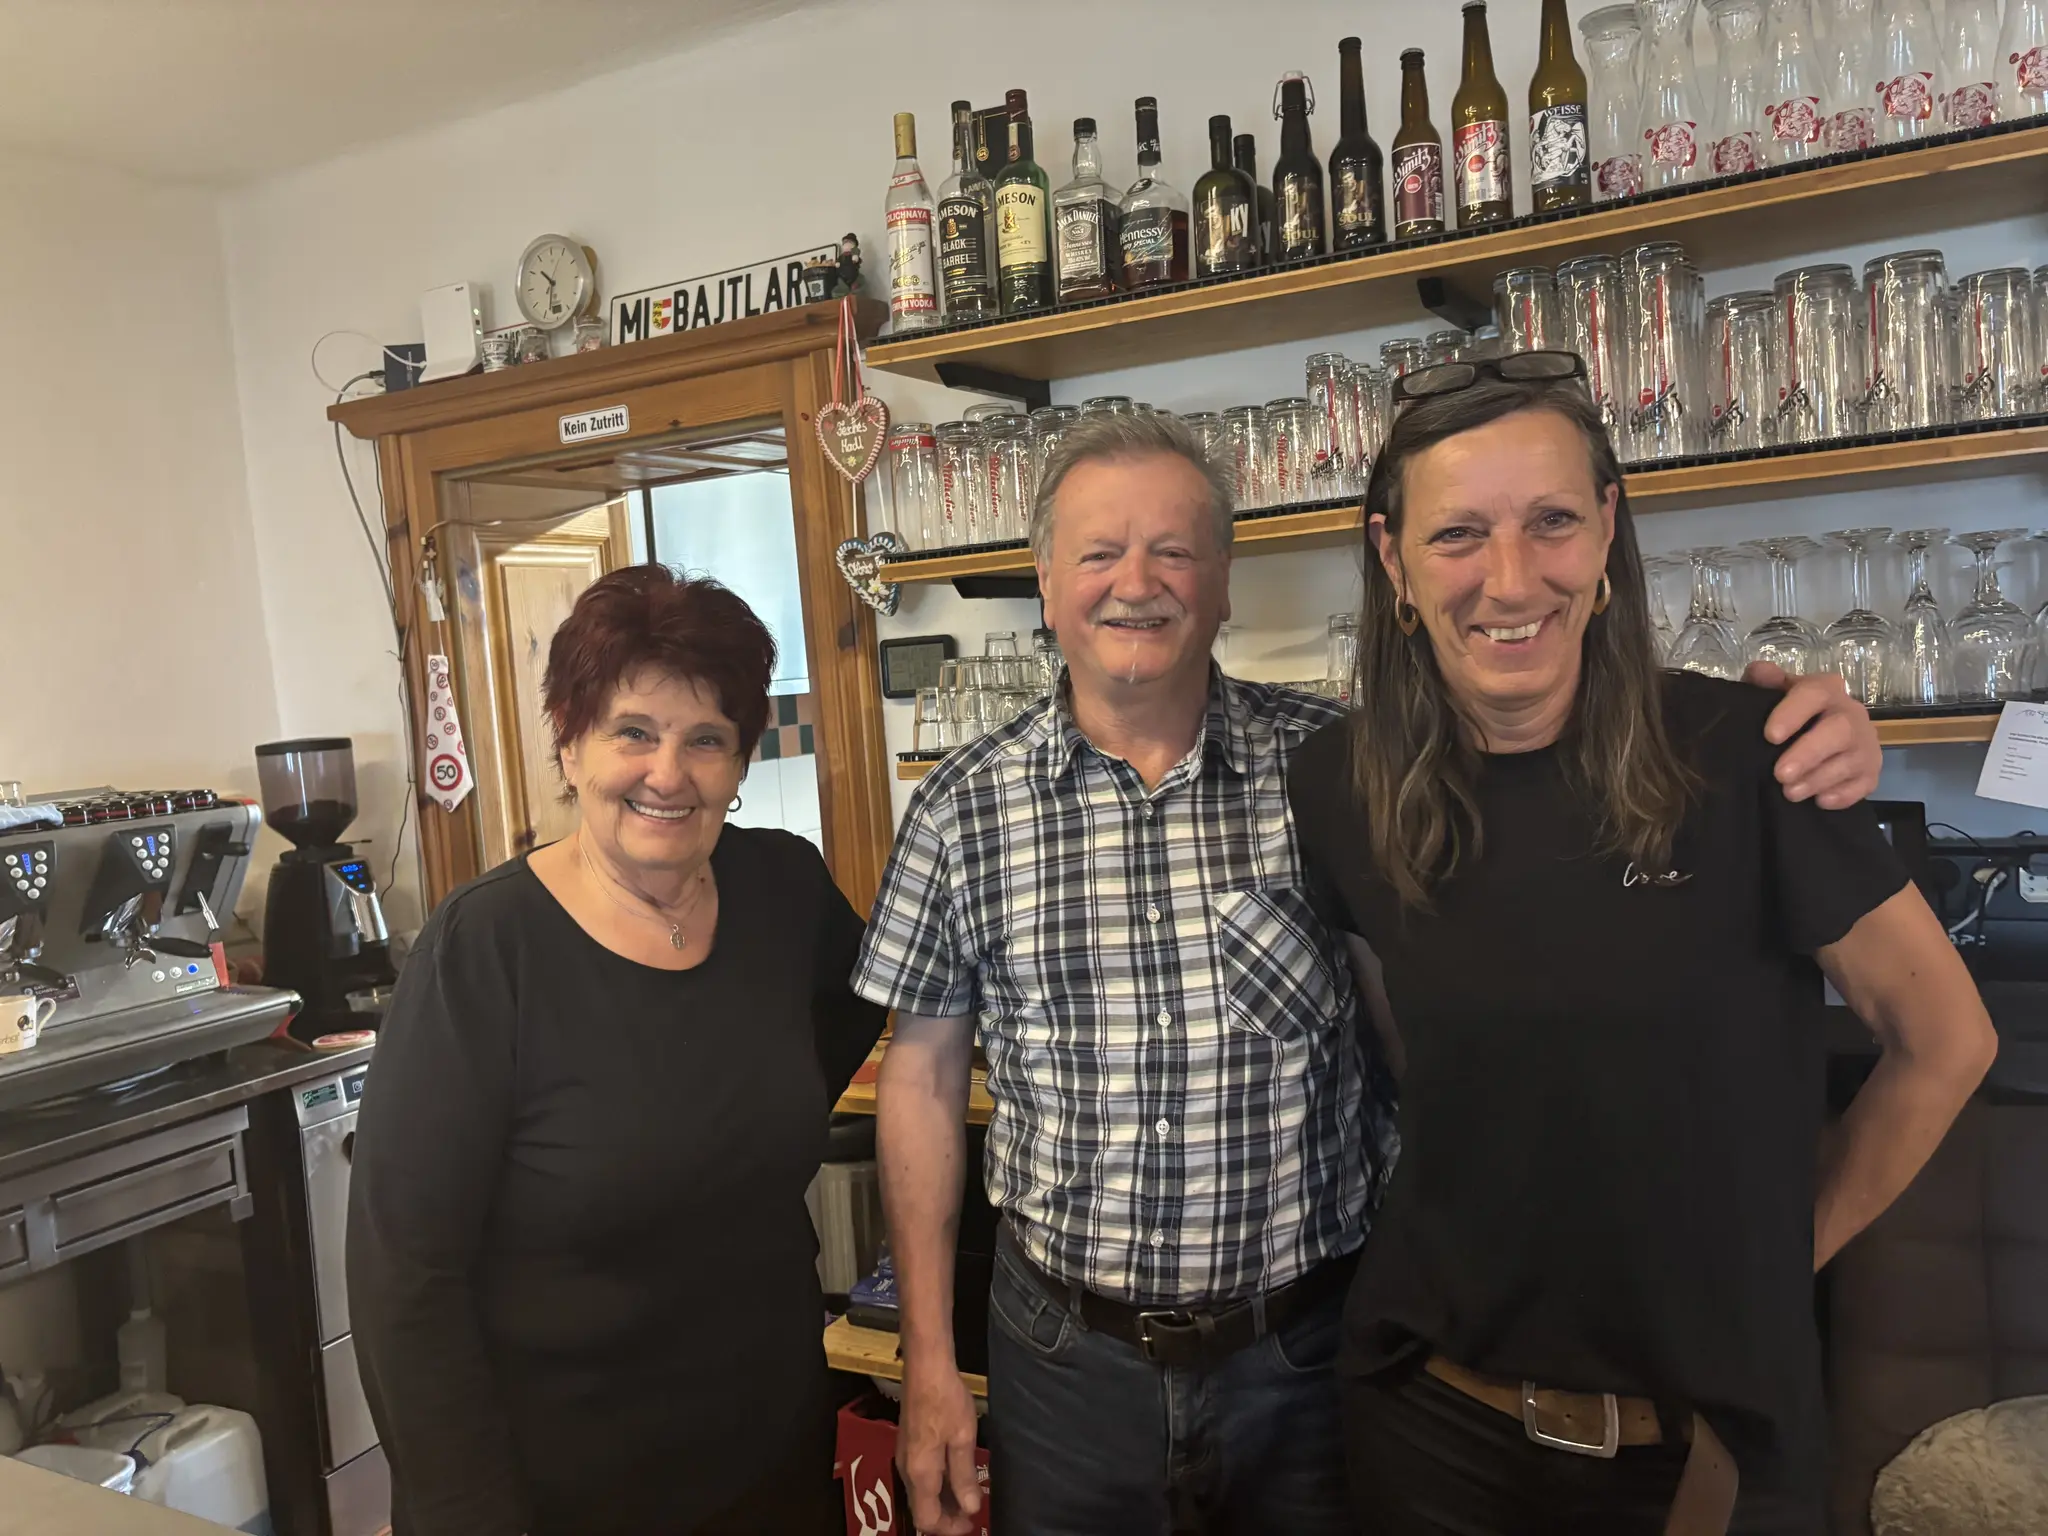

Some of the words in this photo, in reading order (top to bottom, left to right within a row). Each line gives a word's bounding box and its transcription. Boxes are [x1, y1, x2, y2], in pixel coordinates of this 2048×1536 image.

[1057, 214, 1073, 230] JACK
[943, 239, 967, 253] BLACK
[943, 254, 972, 268] BARREL
[673, 254, 828, 333] BAJTLAR
[909, 298, 934, 308] VODKA
[564, 420, 588, 436] Kein
[590, 412, 625, 432] Zutritt
[436, 764, 456, 781] 50
